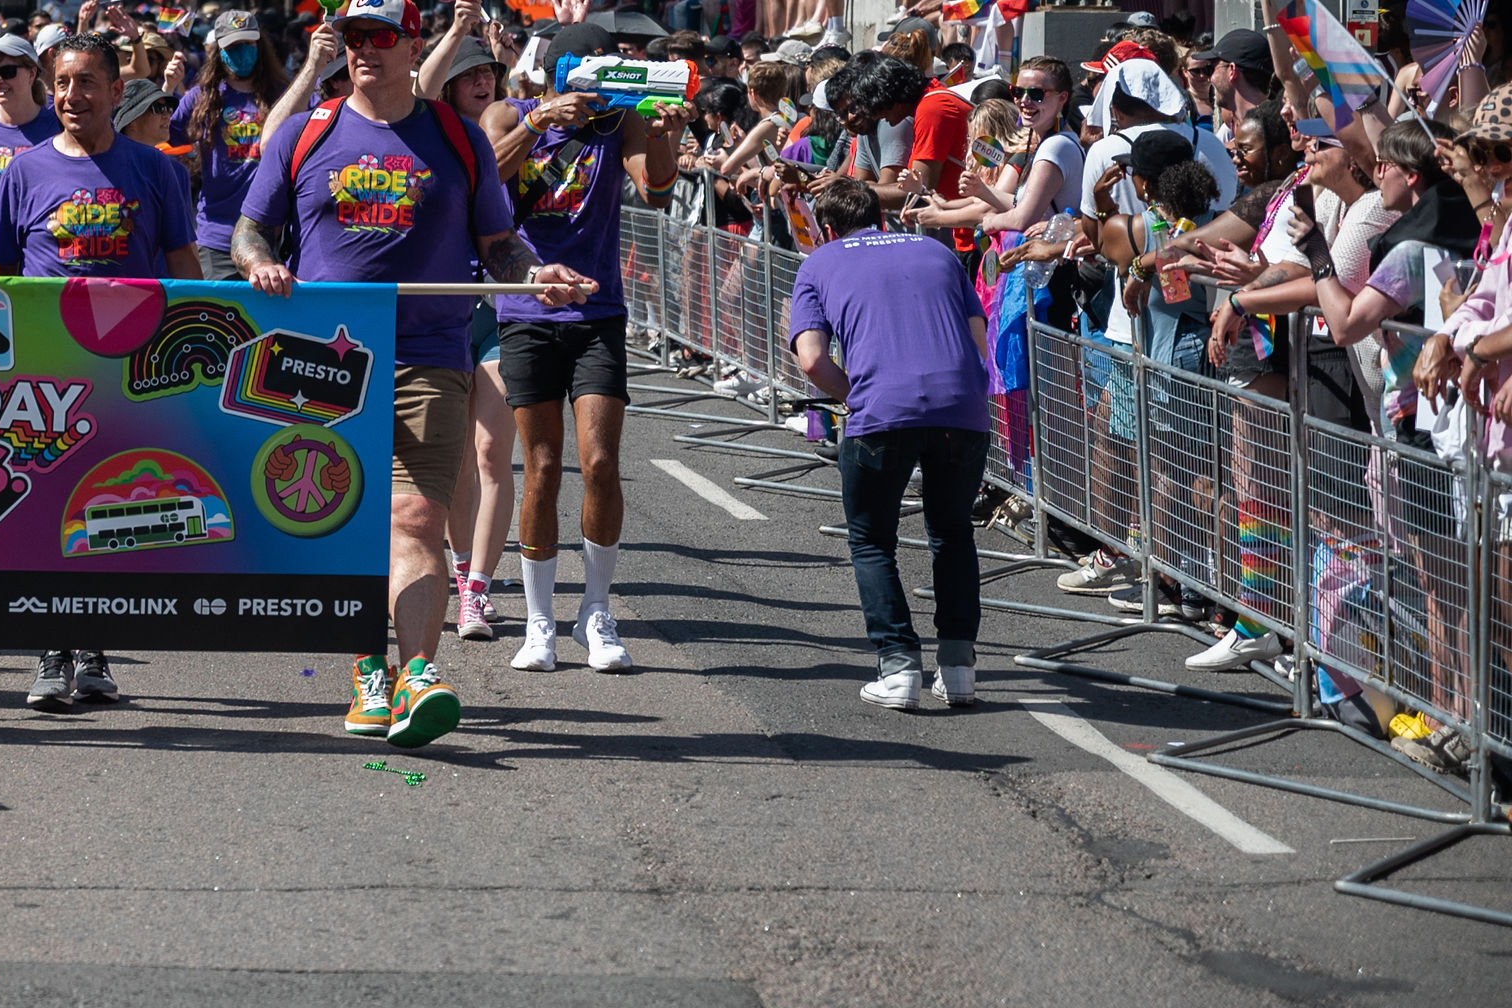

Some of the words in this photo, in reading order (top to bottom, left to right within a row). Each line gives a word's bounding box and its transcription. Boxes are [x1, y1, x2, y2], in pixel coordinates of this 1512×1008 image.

[348, 170, 408, 192] RIDE
[357, 190, 396, 203] WITH
[534, 191, 583, 212] RIDE
[62, 203, 121, 225] RIDE
[337, 201, 414, 227] PRIDE
[73, 224, 113, 237] WITH
[58, 236, 129, 258] PRIDE
[866, 238, 906, 247] PRESTO
[281, 356, 351, 385] PRESTO
[52, 596, 179, 615] METROLINX
[238, 597, 323, 617] PRESTO
[334, 599, 362, 616] UP
